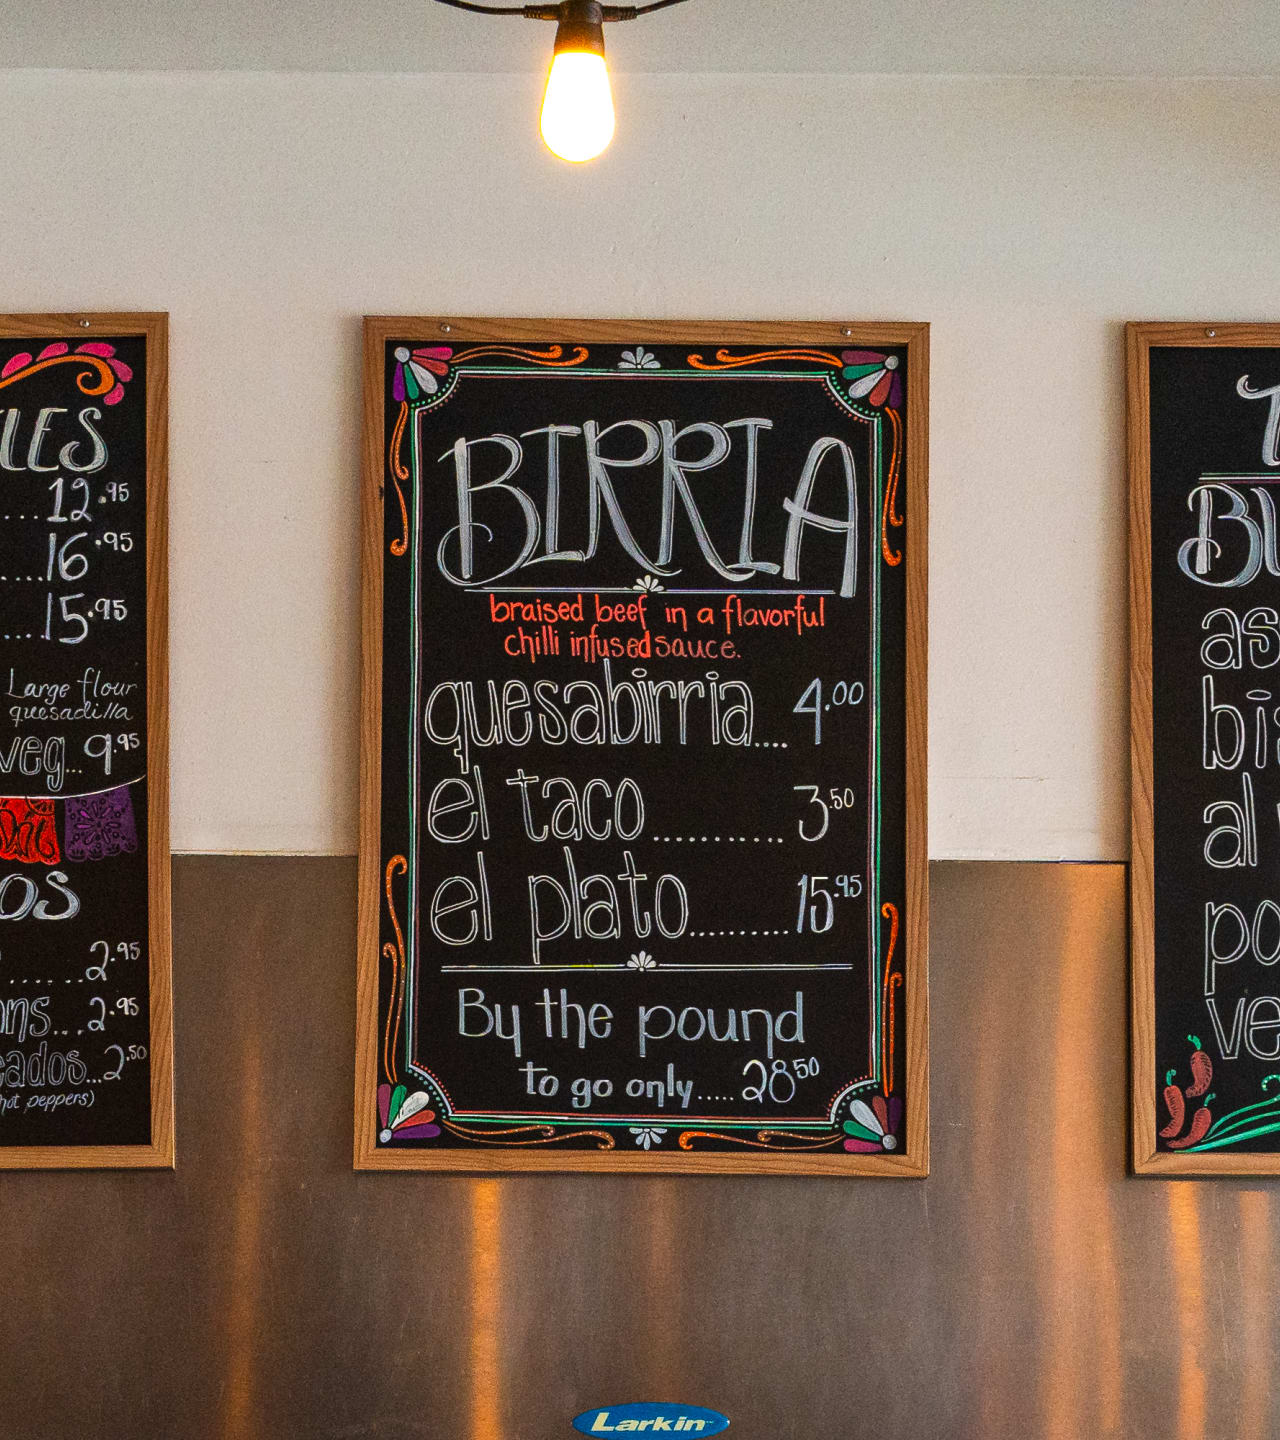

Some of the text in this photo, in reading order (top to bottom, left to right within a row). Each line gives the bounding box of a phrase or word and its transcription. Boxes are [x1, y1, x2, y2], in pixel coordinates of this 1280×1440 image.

[437, 418, 858, 599] BIRRIA
[490, 593, 825, 635] braised beef in a flavorful
[505, 627, 740, 663] chilli infused sauce.
[4, 667, 137, 705] Large flour
[10, 701, 133, 727] quesadilla
[425, 658, 753, 773] quesabirria
[427, 765, 489, 844] el
[506, 768, 644, 843] taco
[1203, 772, 1257, 869] al
[431, 851, 492, 946] el
[528, 847, 688, 965] plato
[458, 987, 806, 1058] By the pound
[519, 1061, 693, 1108] to go only
[591, 1412, 707, 1432] Larkin
